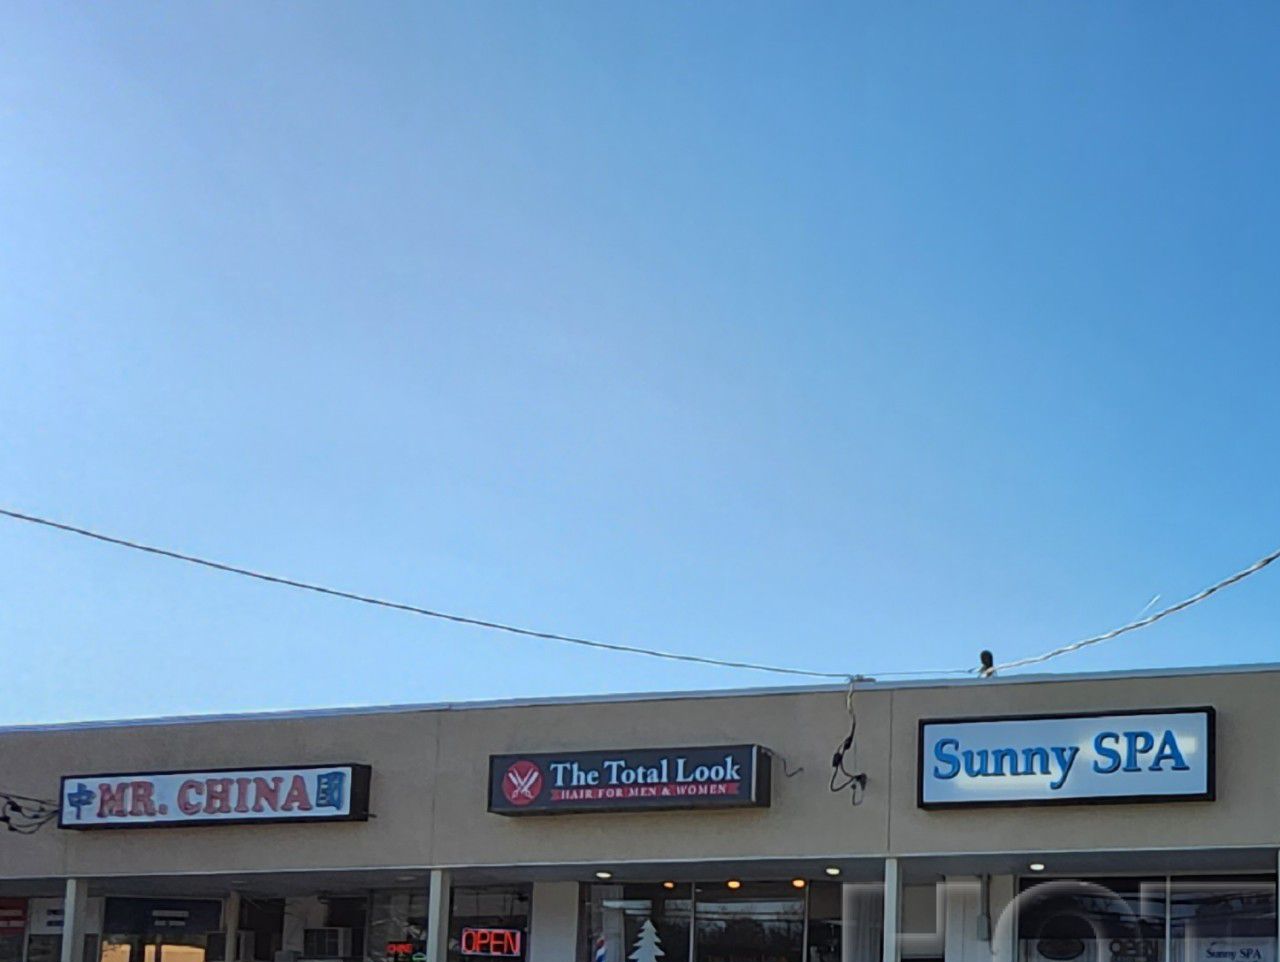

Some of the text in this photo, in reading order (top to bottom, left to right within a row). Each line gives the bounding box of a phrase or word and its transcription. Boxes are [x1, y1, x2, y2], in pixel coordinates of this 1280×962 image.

[550, 755, 741, 788] The Total Look
[934, 730, 1190, 790] Sunny SPA
[67, 783, 96, 820] 中
[96, 780, 168, 818] MR.
[178, 774, 312, 815] CHINA
[561, 783, 728, 800] HAIR FOR MEN & WOMEN
[463, 930, 518, 954] OPEN
[1206, 947, 1262, 960] Sunny SPA
